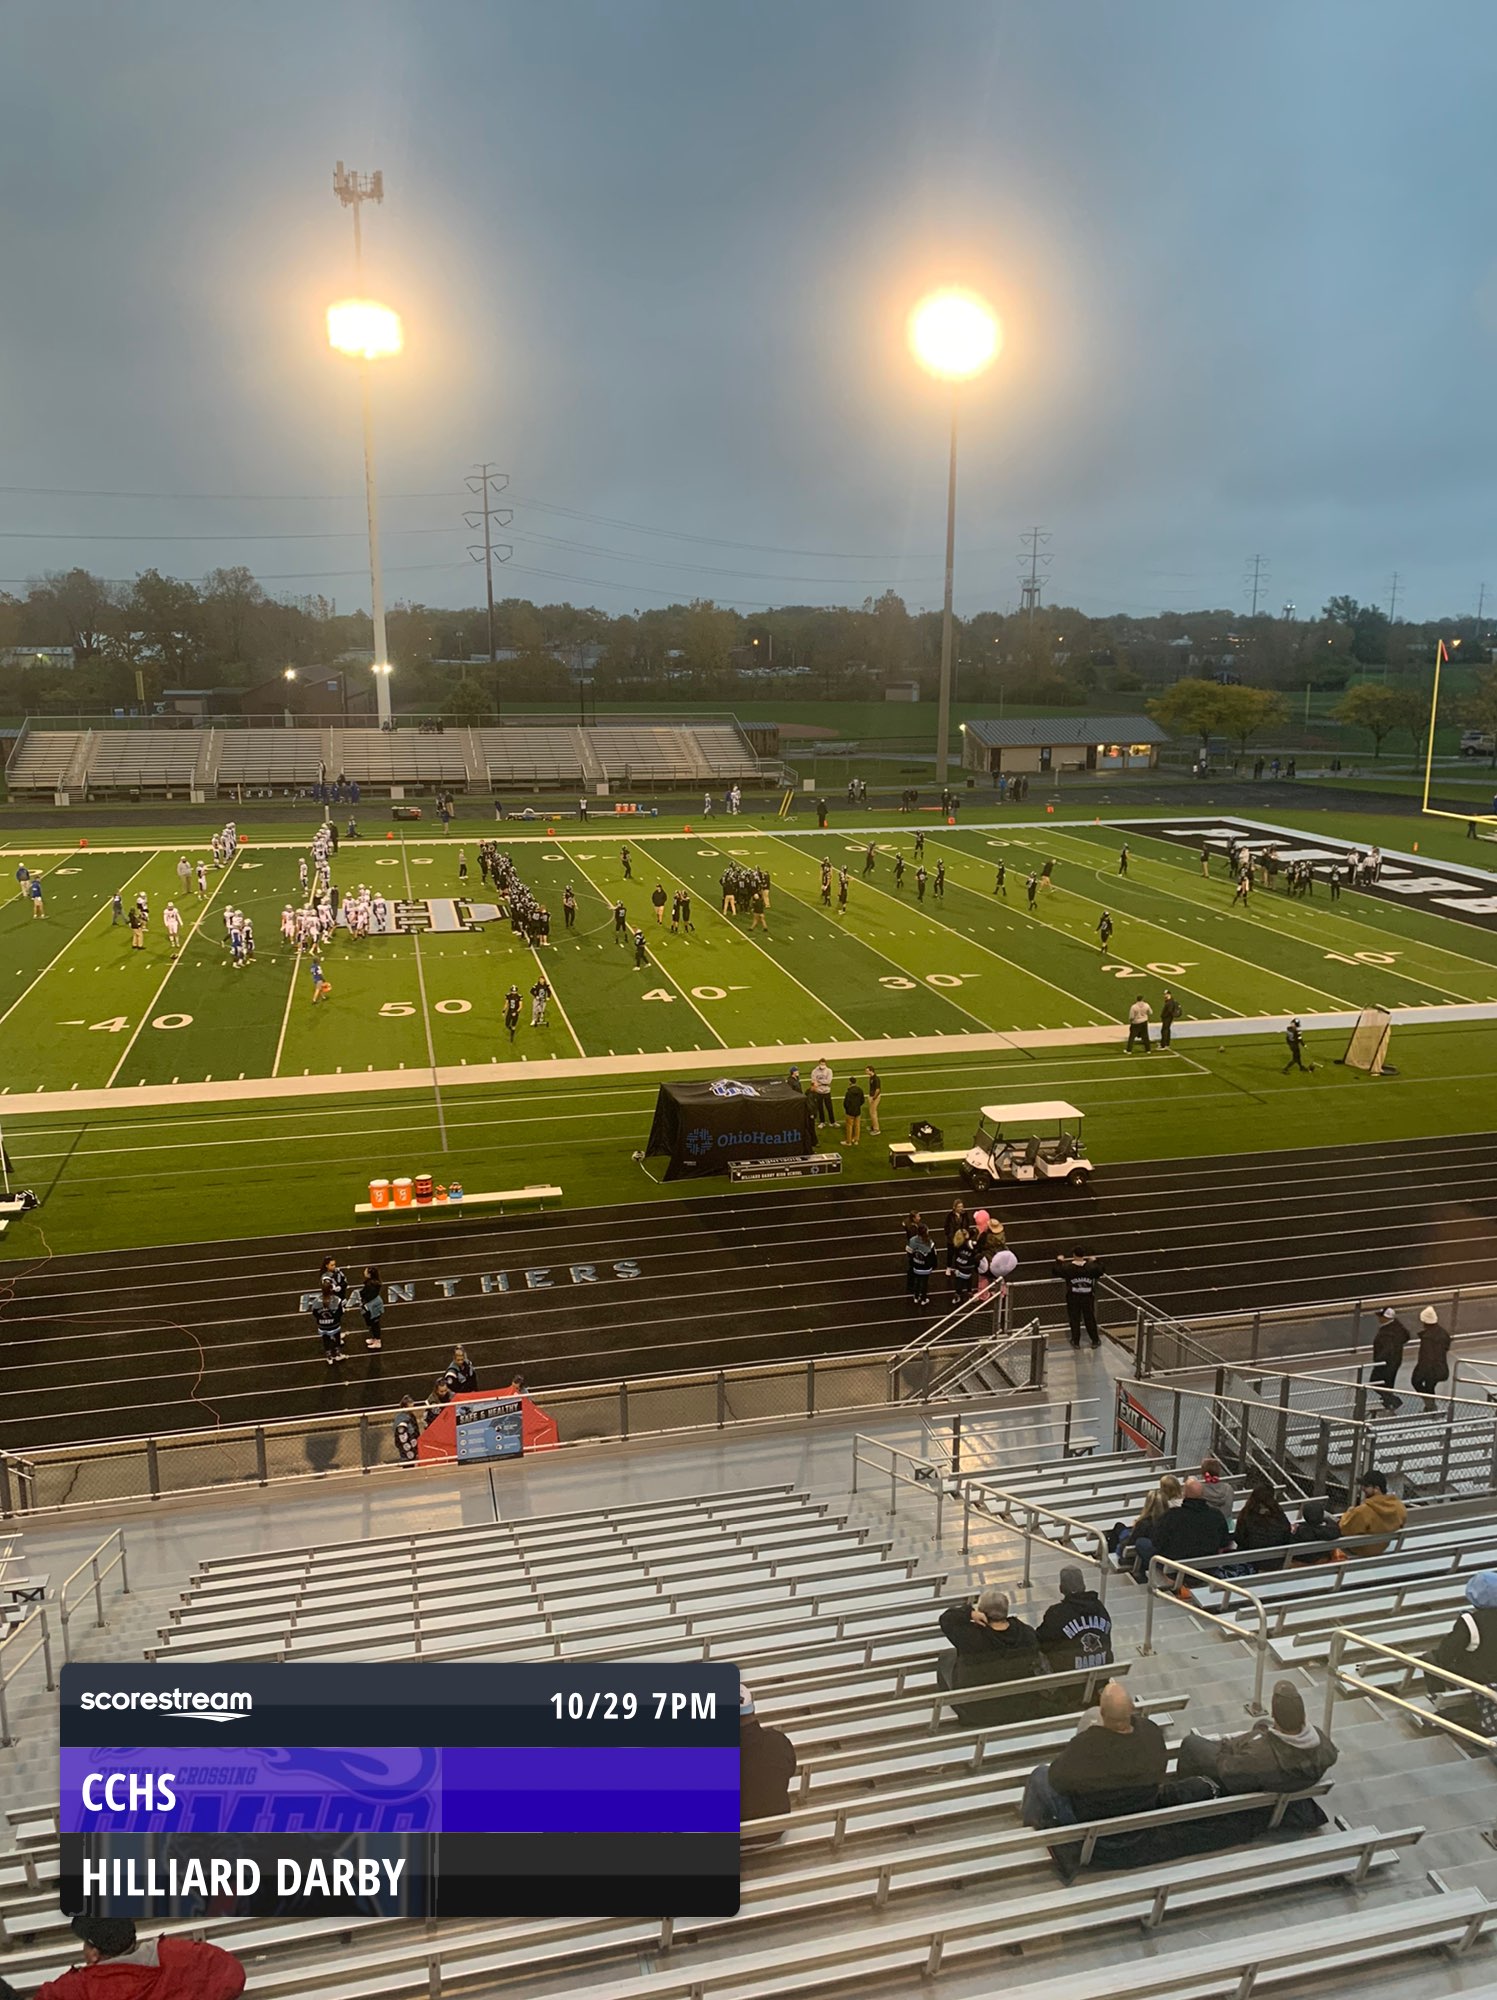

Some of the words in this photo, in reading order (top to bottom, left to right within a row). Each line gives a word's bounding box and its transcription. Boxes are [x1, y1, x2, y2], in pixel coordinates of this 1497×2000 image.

[1101, 962, 1187, 979] 20
[878, 973, 963, 990] 30
[641, 985, 727, 1003] 40
[378, 998, 472, 1018] 50
[717, 1129, 801, 1148] OhioHealth
[459, 1412, 478, 1424] SAFE
[487, 1403, 519, 1418] HEALTHY
[1119, 1401, 1140, 1428] EXIT
[1140, 1416, 1165, 1448] ONLY
